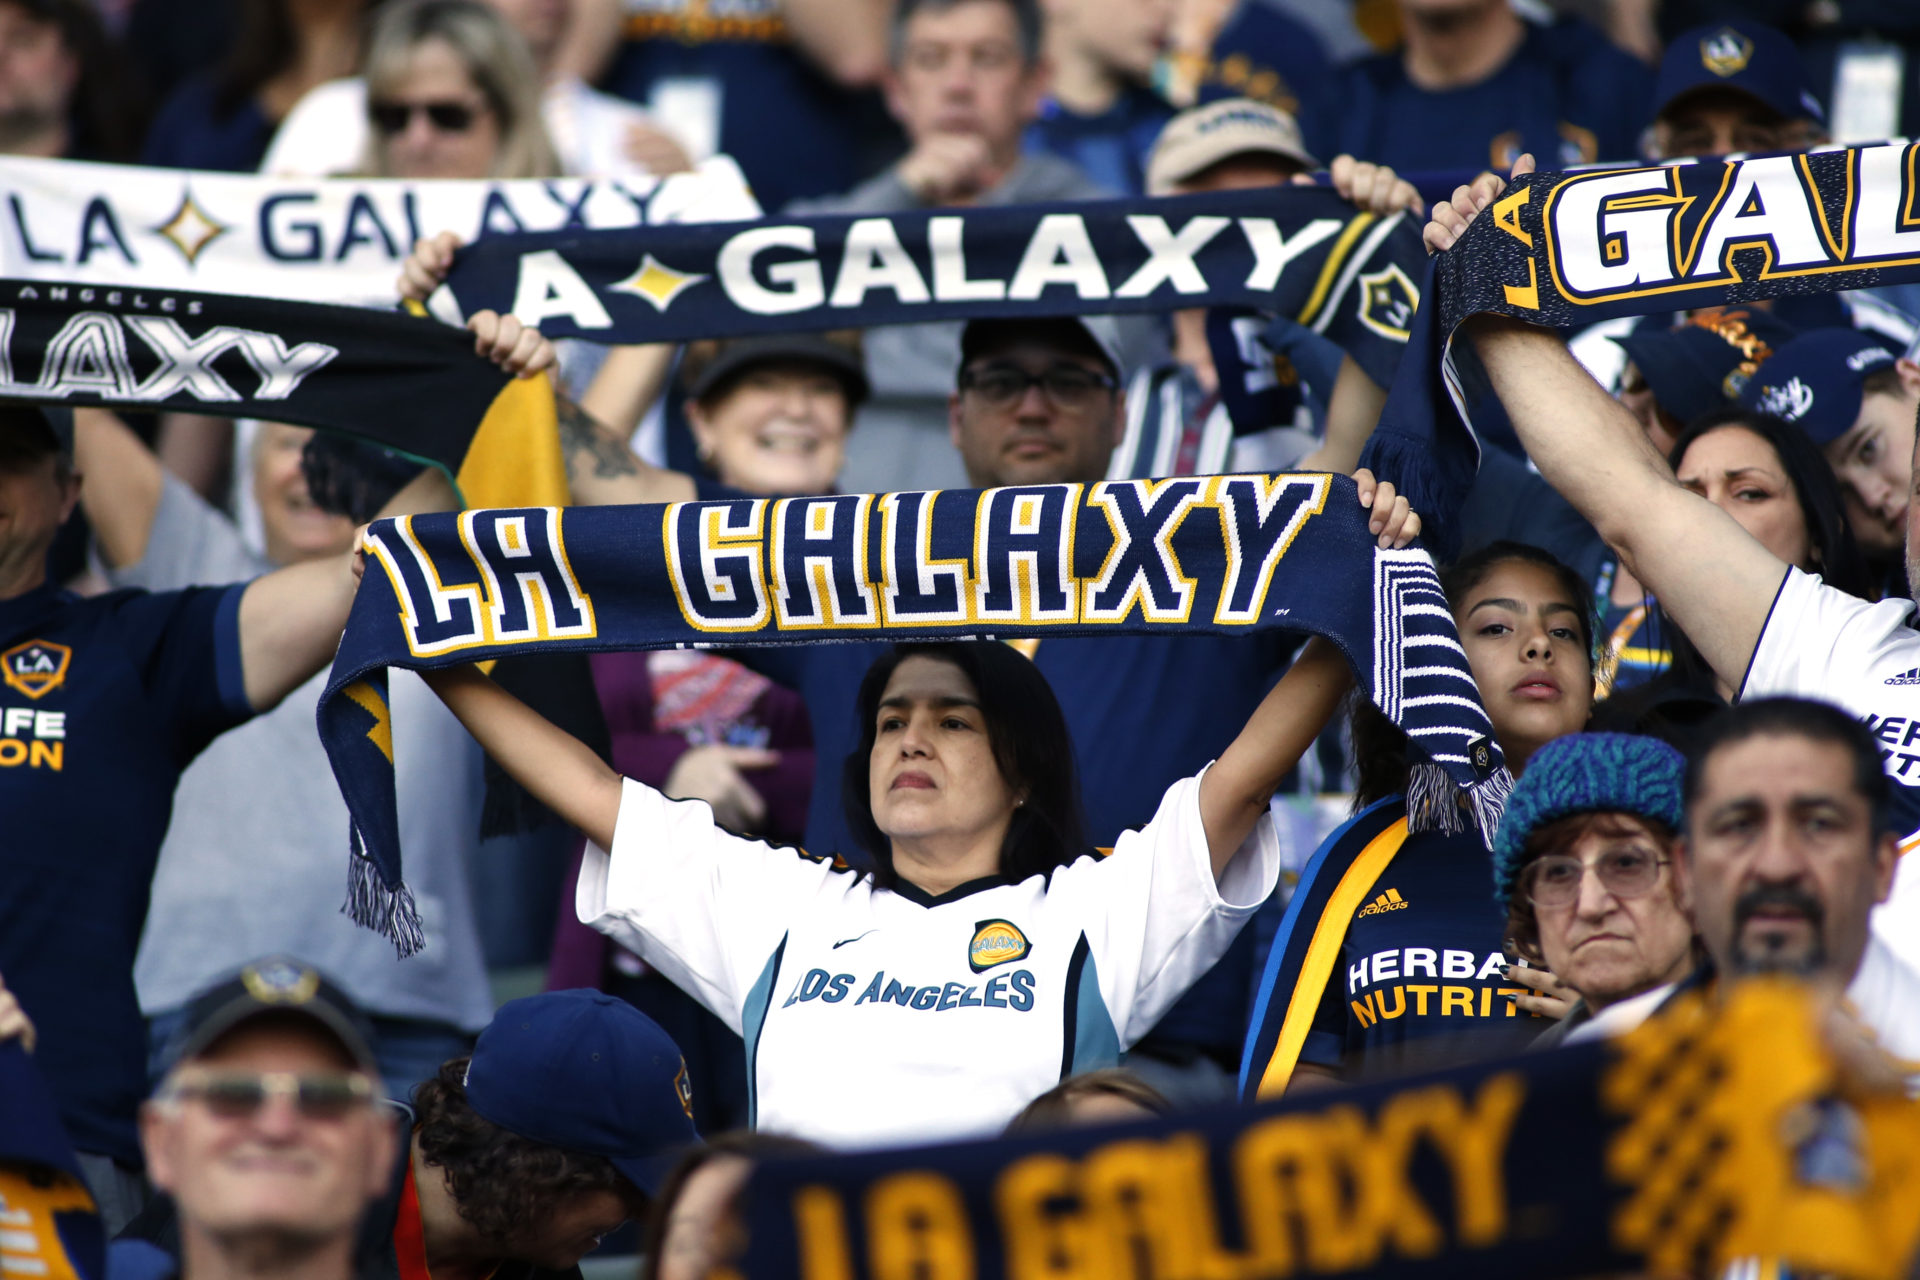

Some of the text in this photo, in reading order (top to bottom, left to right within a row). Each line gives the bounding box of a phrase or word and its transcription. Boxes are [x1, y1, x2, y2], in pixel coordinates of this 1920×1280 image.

[9, 192, 138, 266] LA
[1493, 185, 1541, 311] LA
[716, 213, 1344, 315] GALAXY
[18, 285, 203, 315] ANGELES
[362, 505, 598, 658] LA
[662, 473, 1334, 632] GALAXY
[15, 654, 56, 673] LA
[1358, 900, 1409, 919] adidas
[970, 935, 1027, 954] GALAXY
[781, 967, 1037, 1013] LOS ANGELES
[1349, 947, 1528, 995] HERBA
